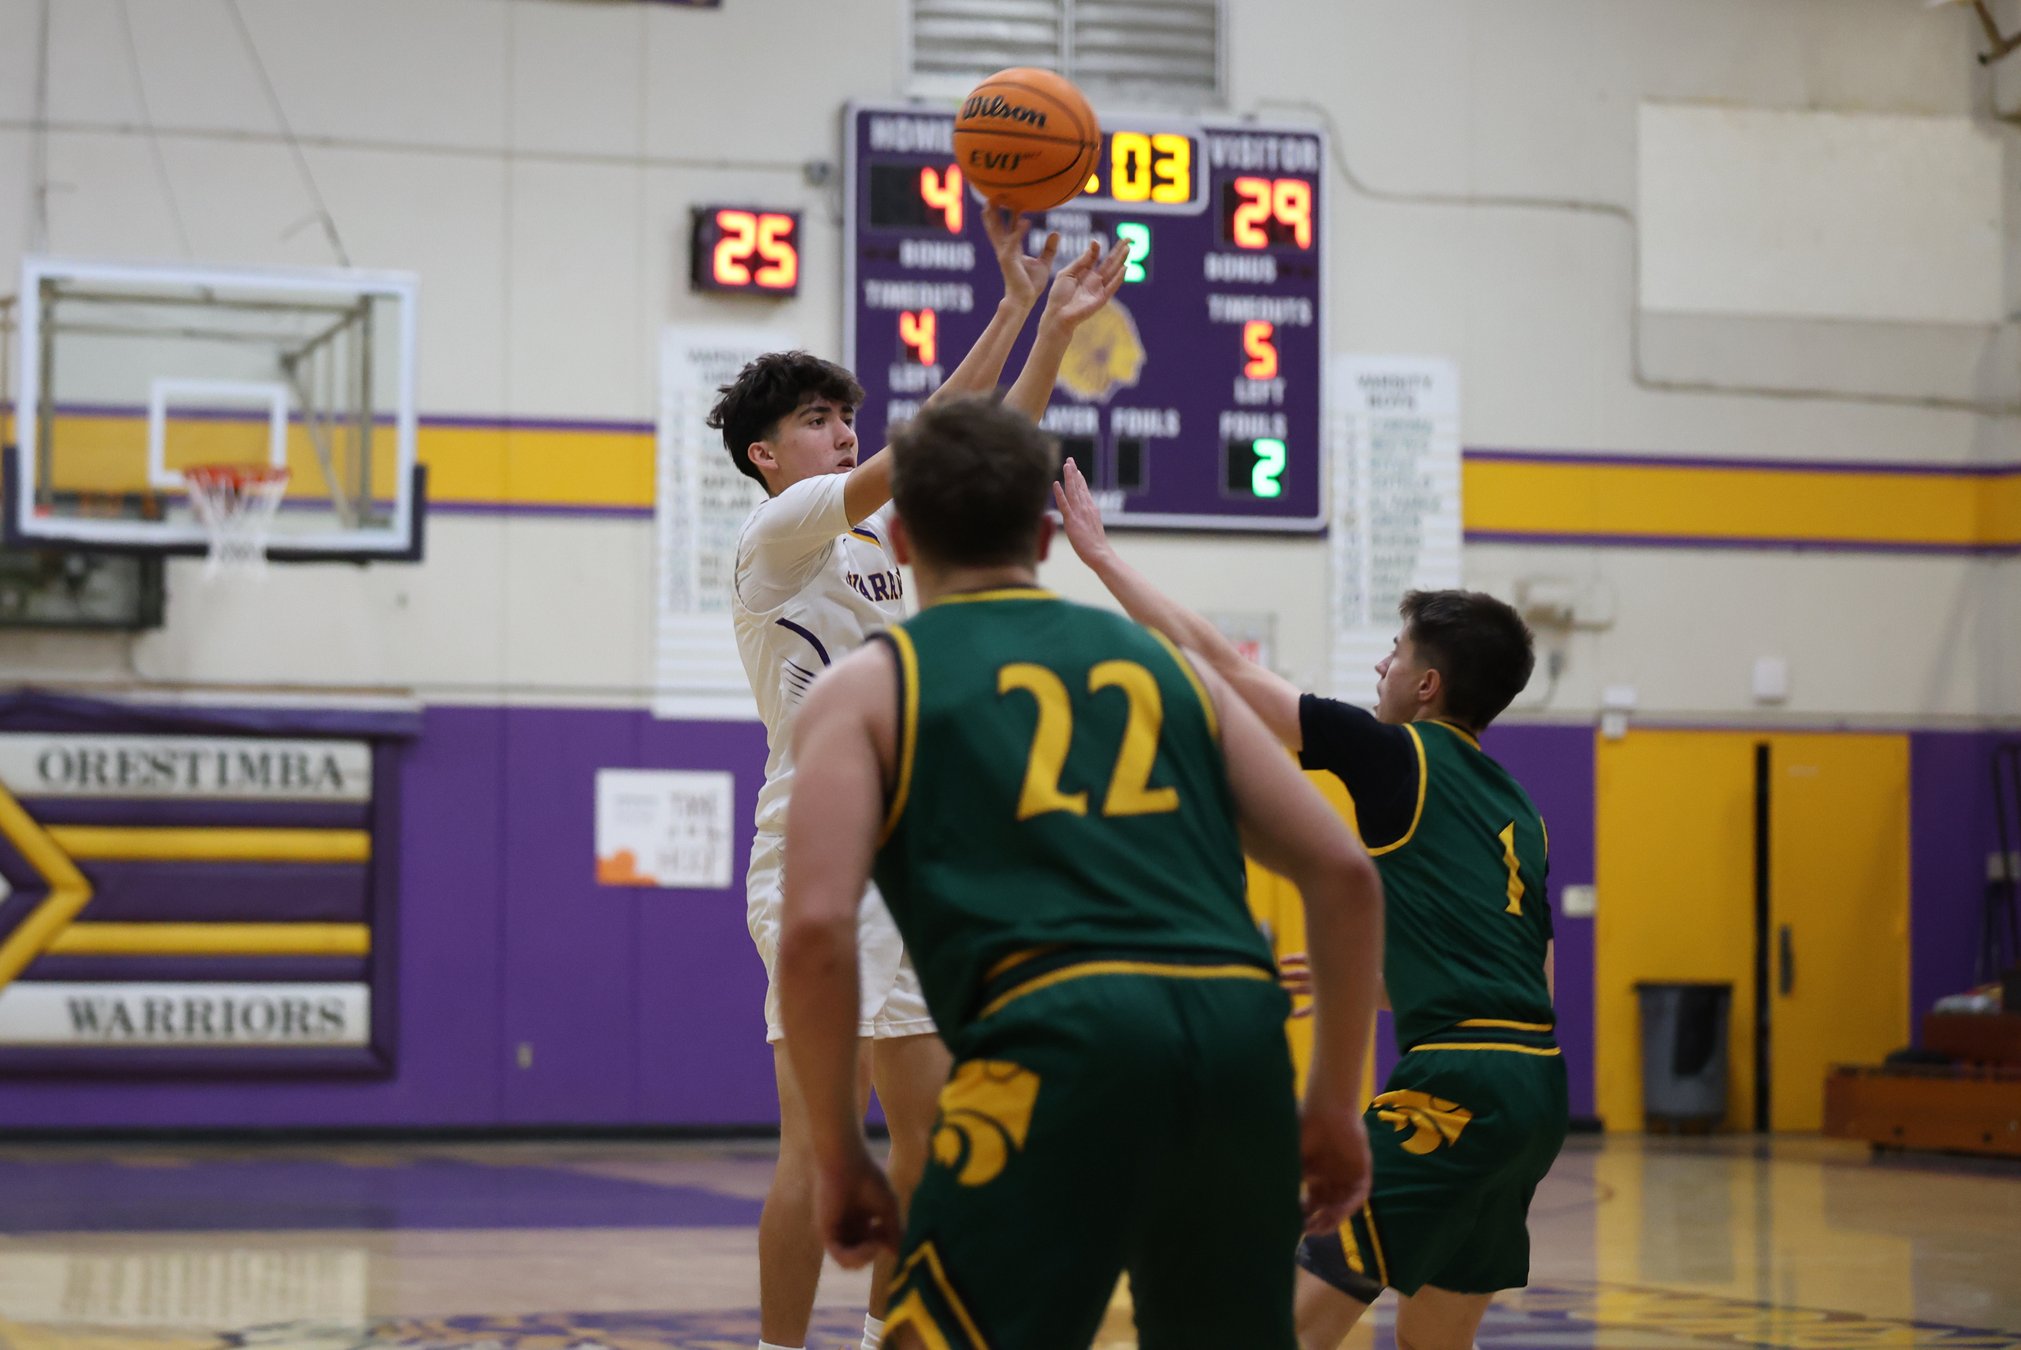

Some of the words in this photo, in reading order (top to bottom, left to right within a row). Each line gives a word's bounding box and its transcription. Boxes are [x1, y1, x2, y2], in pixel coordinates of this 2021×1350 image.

[963, 95, 1047, 128] Wilson
[1209, 133, 1319, 172] VISITOR
[920, 164, 963, 234] 4
[1233, 176, 1313, 250] 29
[713, 209, 799, 289] 25
[899, 239, 976, 271] BONUS
[1116, 222, 1151, 283] 2
[1204, 253, 1277, 284] BONUS
[864, 280, 974, 313] TIMEOUTS
[1206, 294, 1314, 326] TIMEOUTS
[899, 308, 937, 367] 4
[1242, 321, 1279, 380] 5
[888, 362, 944, 393] LEFT
[1234, 376, 1286, 404] LEFT
[1110, 406, 1181, 438] FOULS
[1219, 411, 1289, 439] FOULS
[1250, 437, 1288, 498] 2
[997, 659, 1180, 822] 22
[37, 744, 347, 794] ORESTIMBA
[1498, 820, 1525, 917] 1
[66, 995, 346, 1038] WARRIORS
